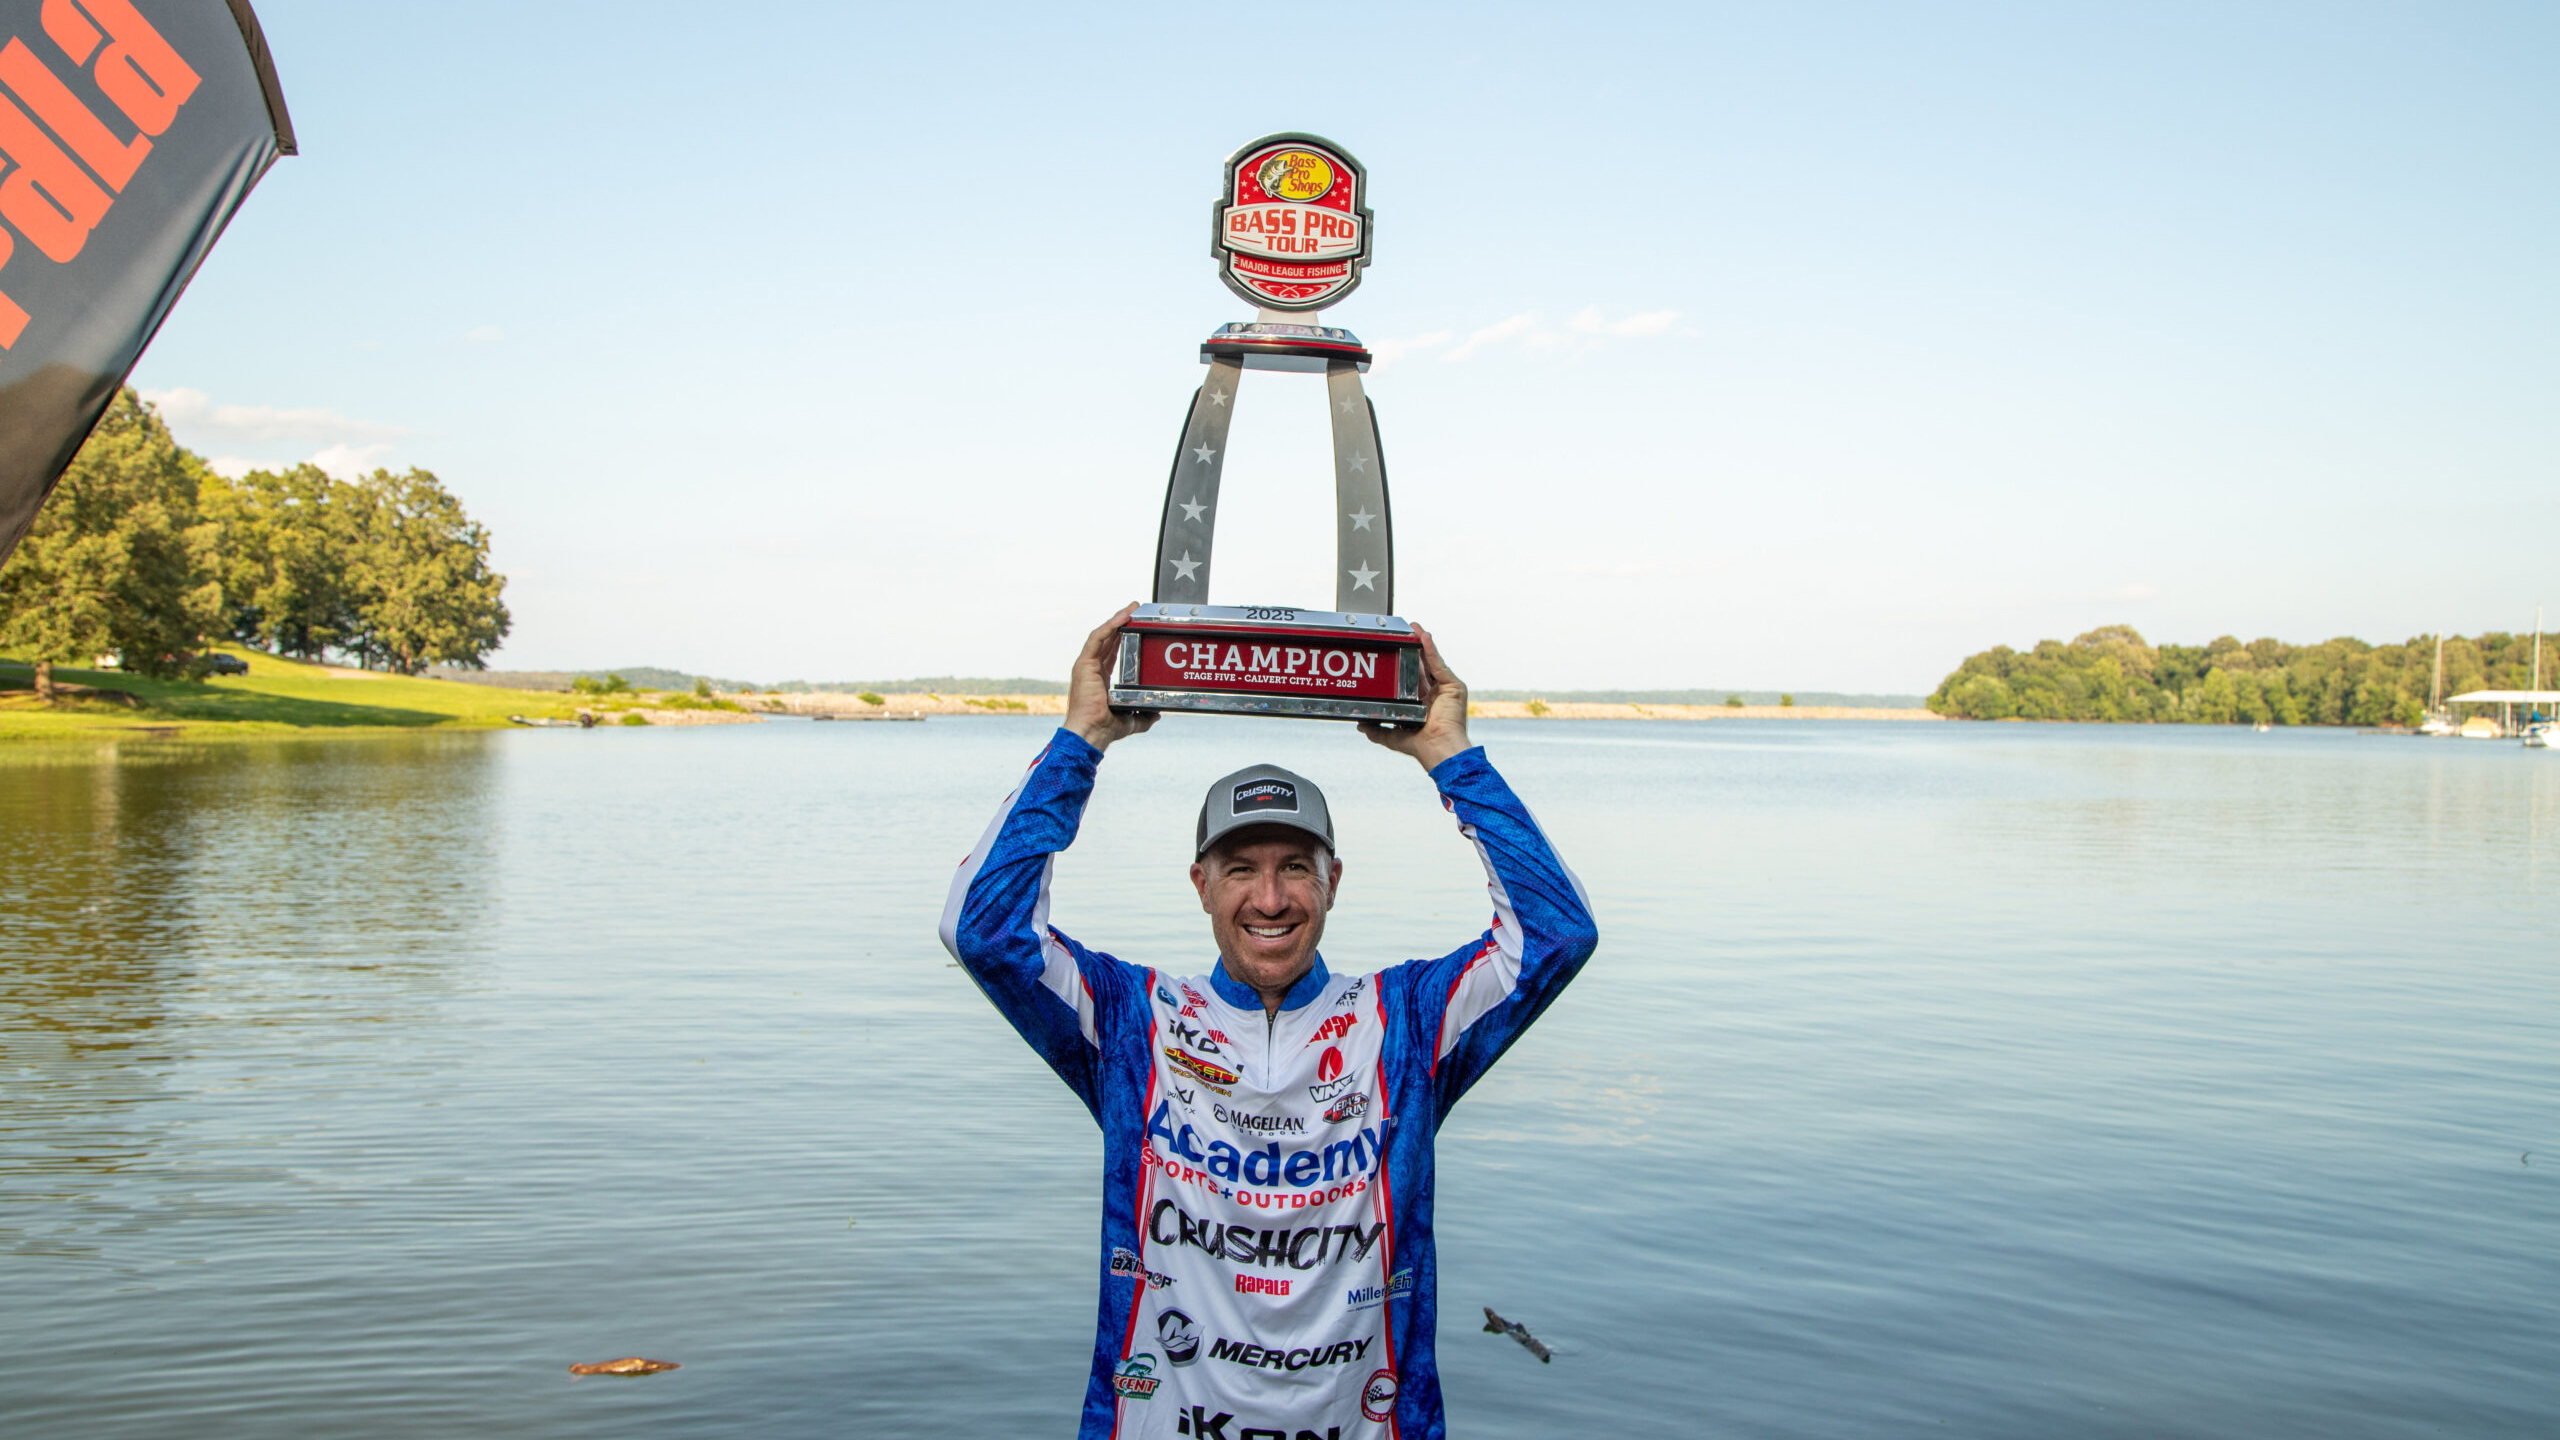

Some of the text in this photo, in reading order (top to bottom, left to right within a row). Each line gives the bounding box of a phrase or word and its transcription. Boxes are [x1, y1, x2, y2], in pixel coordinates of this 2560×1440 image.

[1288, 154, 1317, 169] Bass
[1288, 167, 1310, 180] Pro
[1288, 179, 1323, 195] Shops
[1230, 208, 1355, 239] BASS PRO
[1265, 235, 1319, 254] TOUR
[1240, 258, 1342, 277] MAJOR LEAGUE FISHING
[1246, 608, 1295, 621] 2025
[1164, 642, 1379, 679] CHAMPION
[1183, 671, 1213, 681] STAGE
[1214, 673, 1236, 682] FIVE
[1244, 674, 1288, 685] CALVERT
[1289, 677, 1313, 687] CITY,
[1315, 678, 1328, 687] KY
[1336, 679, 1357, 688] 2025
[1236, 784, 1294, 801] CRUSHCITY
[1169, 1018, 1245, 1075] iKO
[1164, 1046, 1241, 1083] DUKETT
[1230, 1109, 1305, 1131] MAGELLAN
[1146, 1099, 1391, 1187] Academy
[1149, 1198, 1386, 1270] CRUSHCITY
[1207, 1335, 1374, 1372] MERCURY
